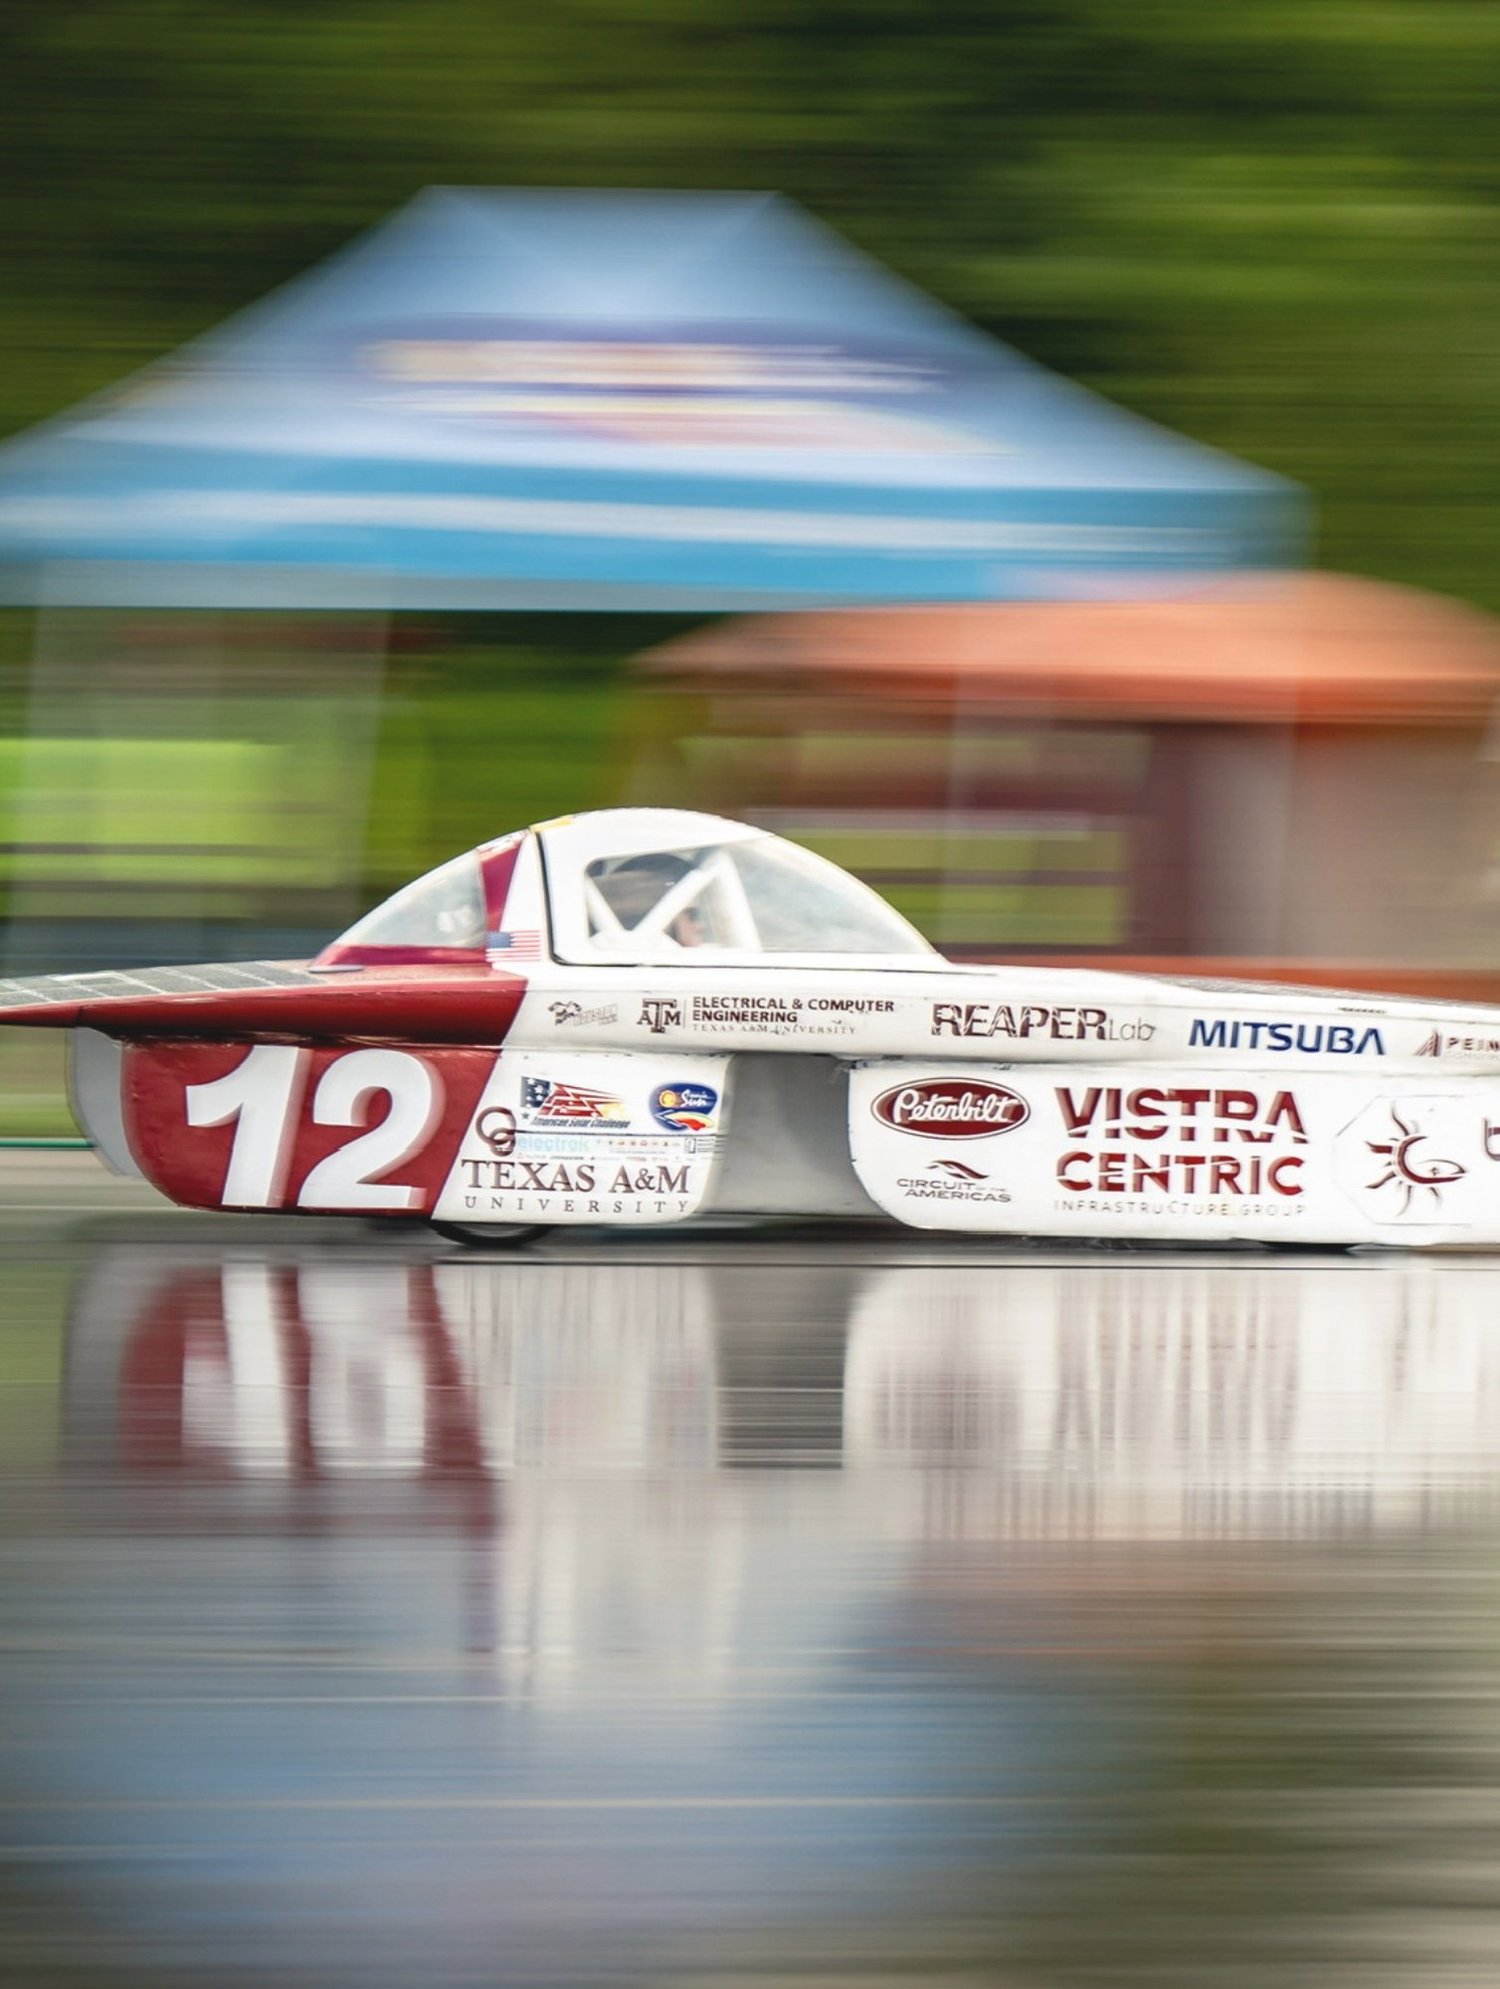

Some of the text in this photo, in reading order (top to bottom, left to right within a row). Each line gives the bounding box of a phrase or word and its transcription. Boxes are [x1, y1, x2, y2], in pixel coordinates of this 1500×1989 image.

[693, 996, 894, 1012] ELECTRICAL & COMPUTER
[693, 1009, 798, 1023] ENGINEERING
[693, 1024, 735, 1032] TEXAS
[772, 1024, 856, 1034] UNIVERSITY
[1188, 1018, 1386, 1056] MITSUBA
[893, 1088, 1021, 1124] Peterbilt
[568, 1117, 590, 1127] Solar
[590, 1118, 631, 1129] Challenge
[1054, 1086, 1309, 1144] VISTRA
[185, 1044, 441, 1210] 12
[461, 1158, 692, 1194] TEXAS A&M
[1056, 1151, 1306, 1197] CENTRIC
[896, 1178, 976, 1190] CIRCUIT
[904, 1188, 1012, 1203] AMERICAS
[464, 1196, 689, 1213] UNIVERSITY
[1054, 1200, 1306, 1217] INFRASTRUCTURE GROUP
